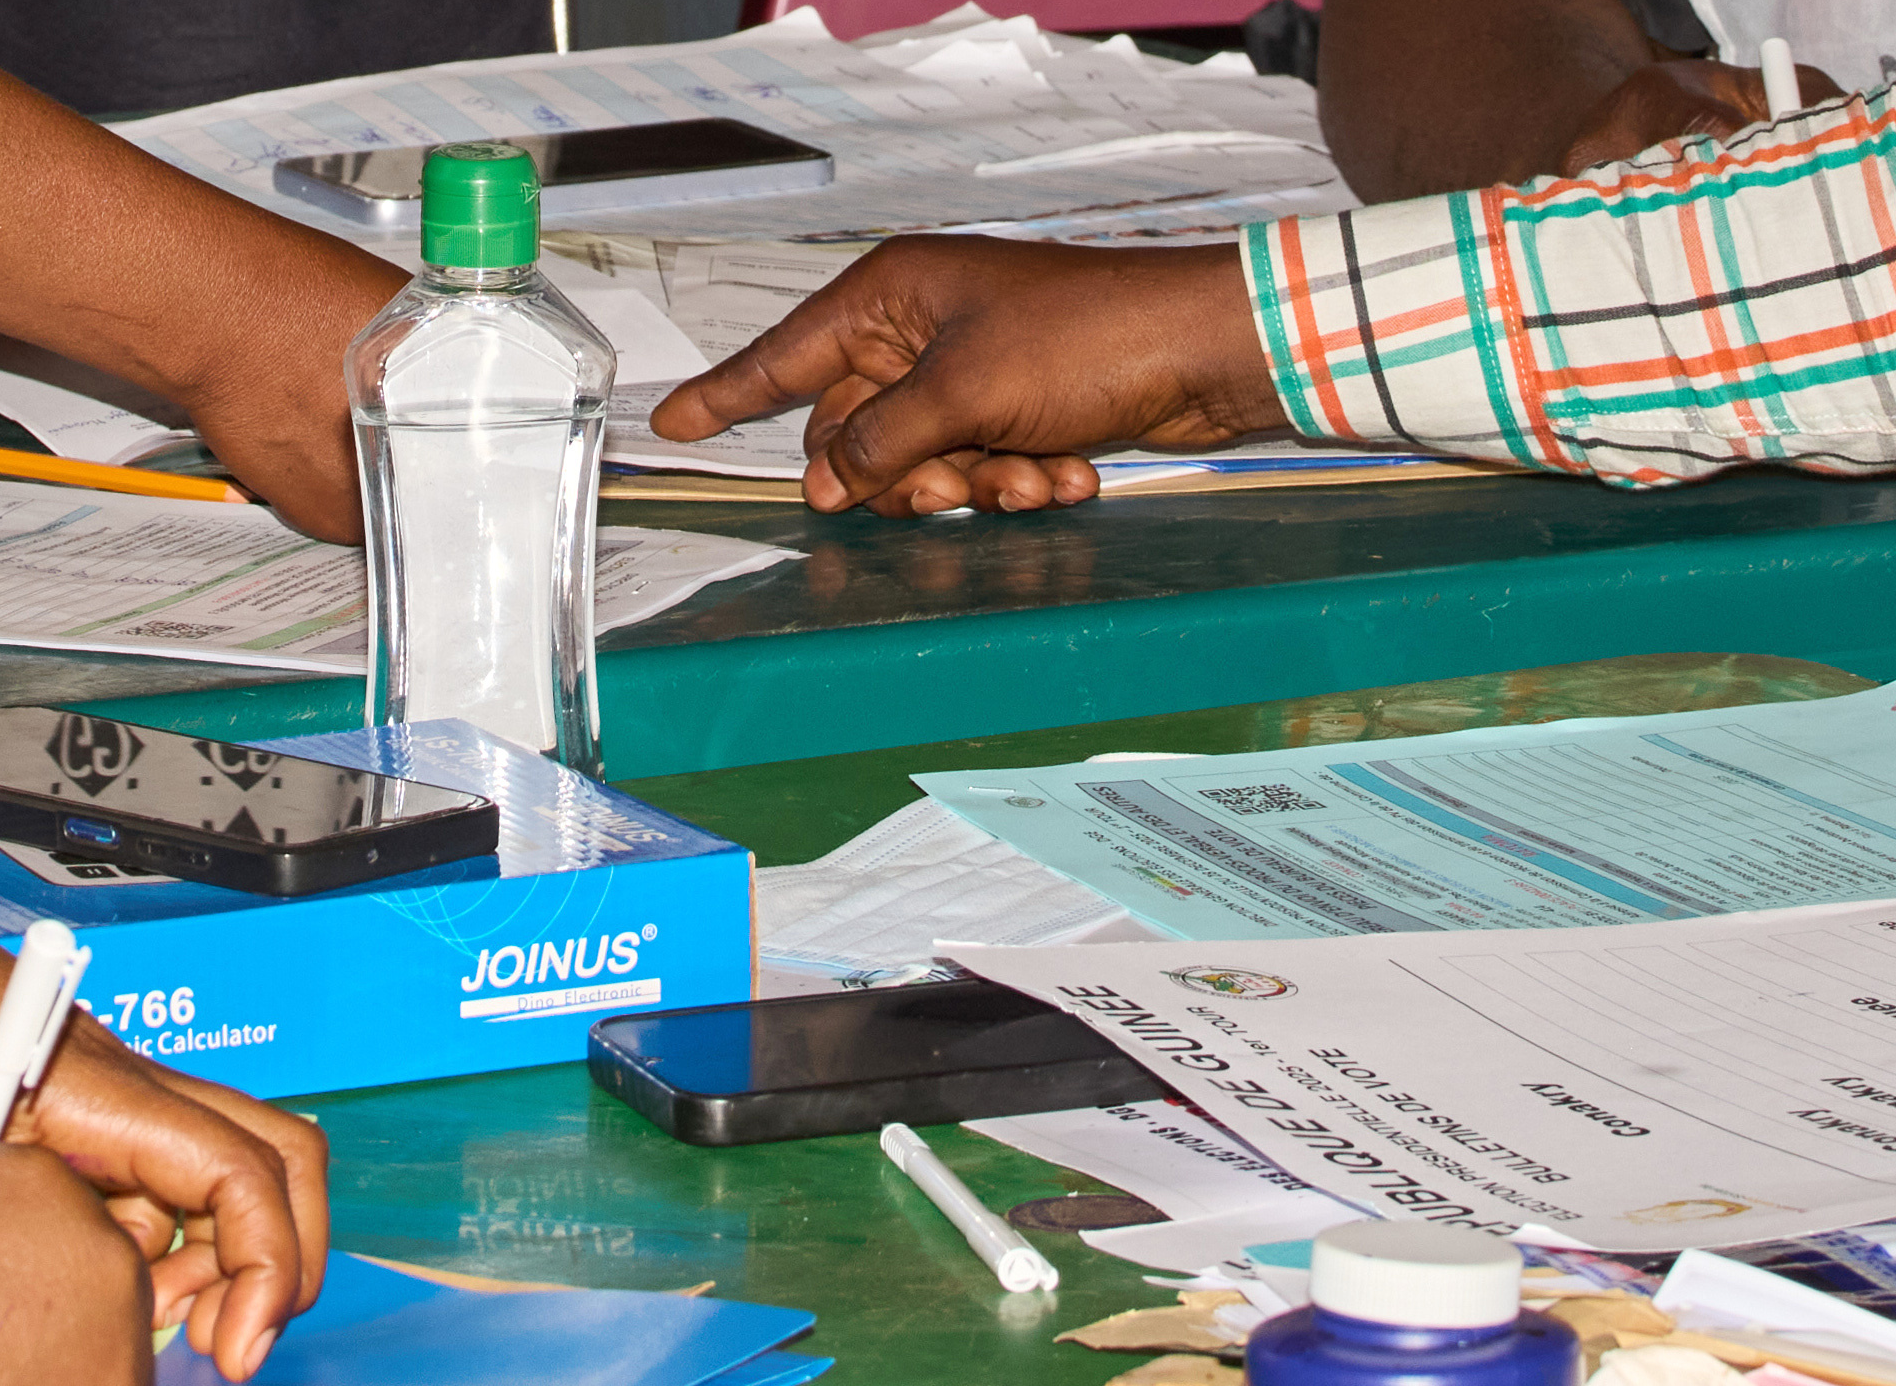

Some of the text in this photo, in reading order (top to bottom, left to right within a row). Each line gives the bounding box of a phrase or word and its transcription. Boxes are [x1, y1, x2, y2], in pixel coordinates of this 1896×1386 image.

[1302, 919, 1348, 936] LECTION
[79, 986, 196, 1031] -766
[517, 983, 643, 1012] Dino Electronic
[156, 1020, 278, 1057] Calculator
[1185, 1006, 1247, 1035] TOUR
[1277, 1065, 1332, 1091] 2025
[1056, 985, 1518, 1235] EPUBLIQUE DE GUINÉE
[1308, 1048, 1570, 1183] BULLETINS DE VOTE
[1521, 1083, 1650, 1136] Conakry
